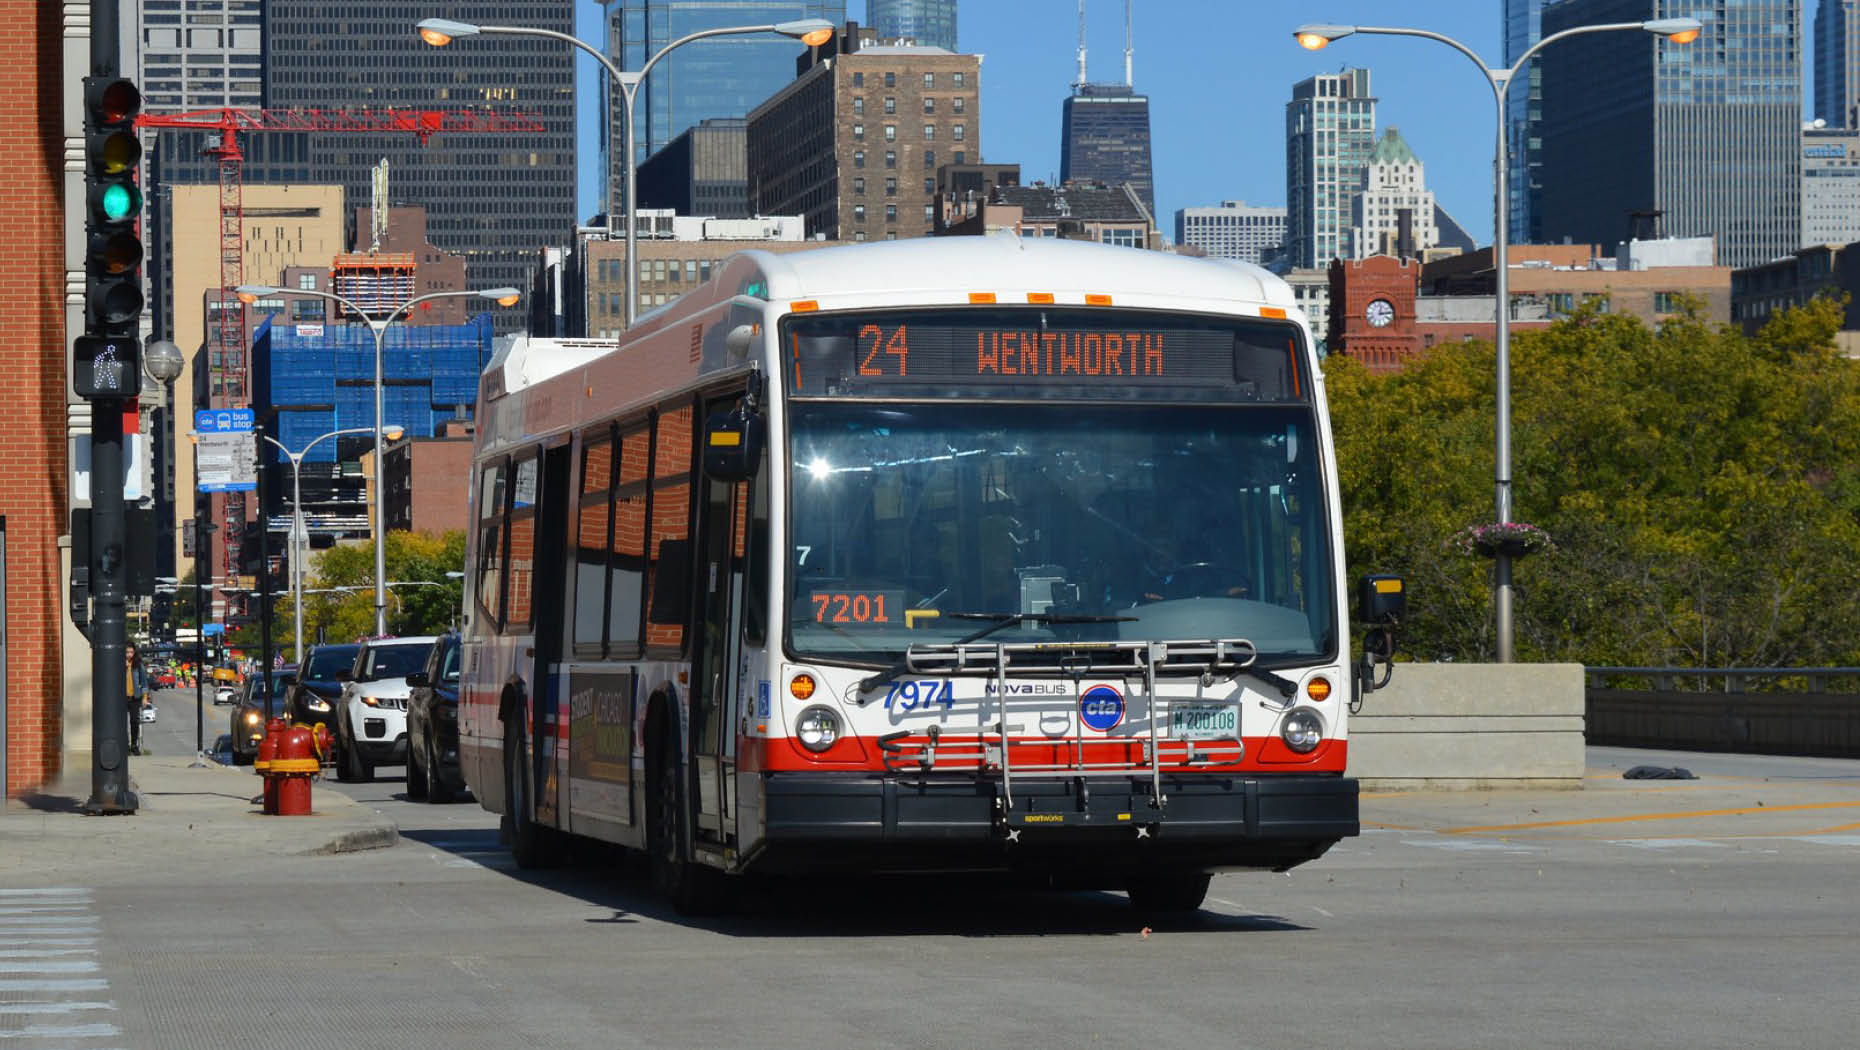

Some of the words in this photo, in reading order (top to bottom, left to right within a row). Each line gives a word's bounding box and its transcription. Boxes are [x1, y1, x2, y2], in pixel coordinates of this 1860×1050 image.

[857, 324, 909, 376] 24
[977, 332, 1164, 376] WENTWORTH
[233, 411, 249, 420] bus
[233, 420, 252, 430] stop
[796, 545, 811, 566] 7
[811, 594, 889, 623] 7201
[883, 680, 956, 710] 7974
[1086, 700, 1118, 716] cta
[1187, 711, 1235, 730] 200108
